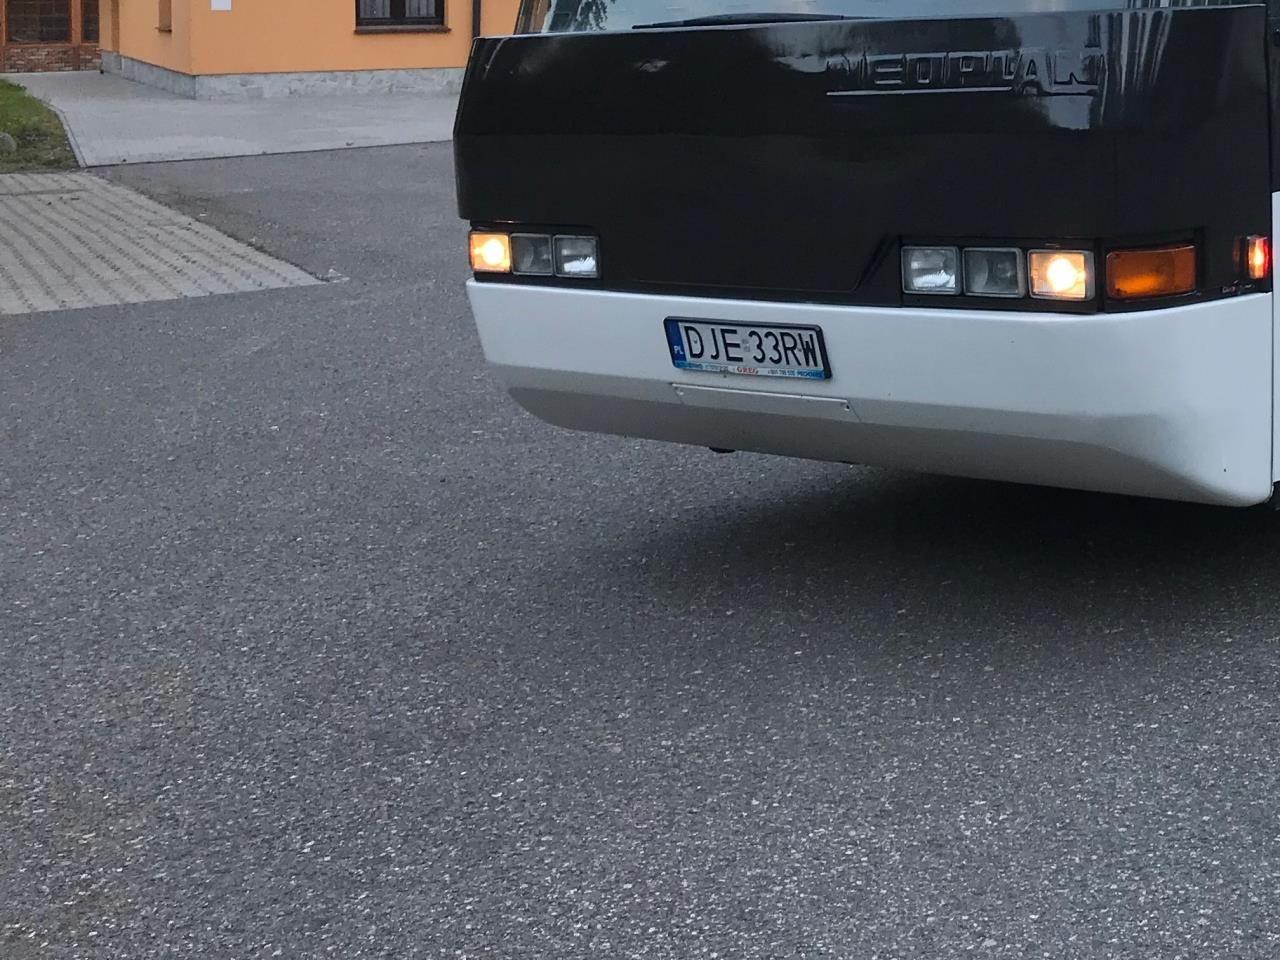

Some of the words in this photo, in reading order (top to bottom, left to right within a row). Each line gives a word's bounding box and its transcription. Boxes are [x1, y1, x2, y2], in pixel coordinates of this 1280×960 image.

[673, 345, 684, 355] PL
[684, 325, 744, 363] DJE
[748, 330, 819, 368] 33RW
